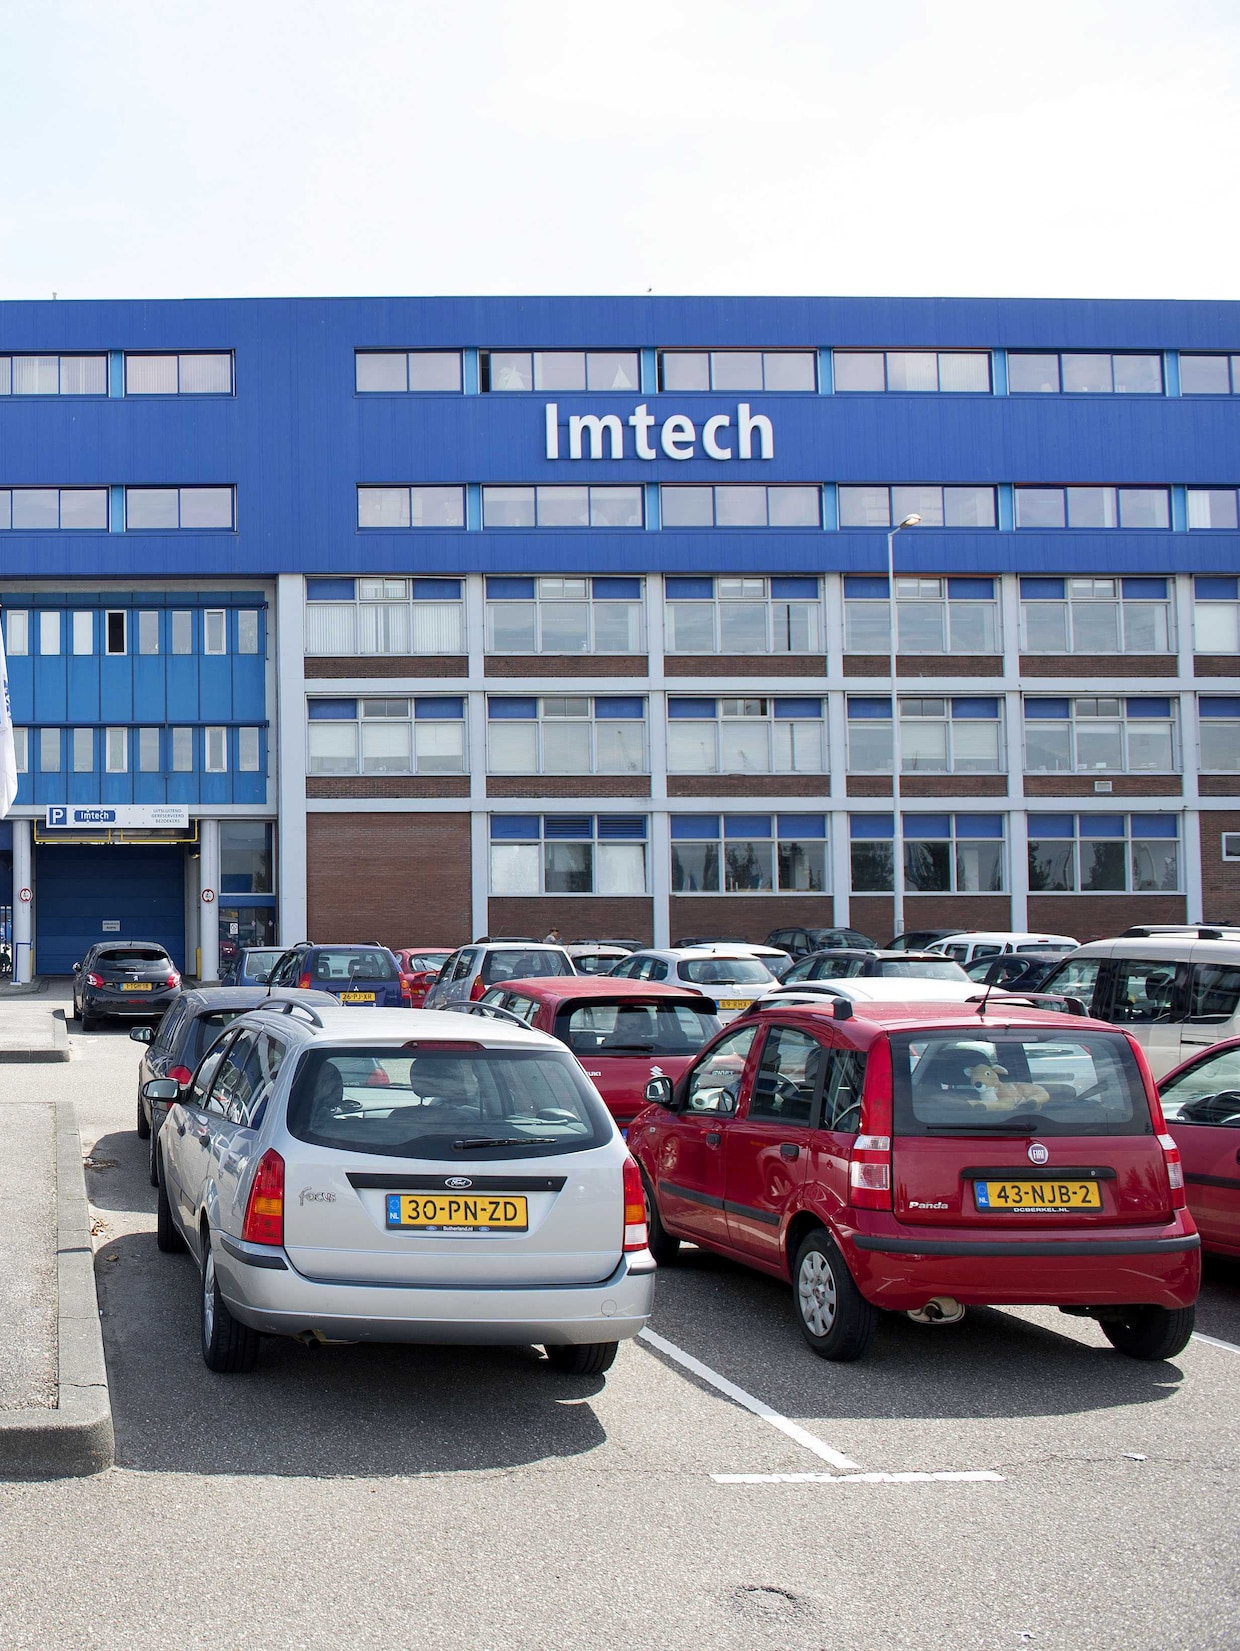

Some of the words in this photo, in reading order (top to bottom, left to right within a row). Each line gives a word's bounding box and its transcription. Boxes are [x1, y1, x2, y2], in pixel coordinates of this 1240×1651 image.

[545, 403, 774, 461] Imtech
[52, 809, 64, 824] P
[80, 811, 110, 820] Imtech
[978, 1196, 988, 1204] NL
[997, 1184, 1092, 1204] 43-NJB-2
[389, 1212, 400, 1220] NL
[407, 1199, 518, 1221] 30-PN-ZD
[909, 1201, 949, 1209] Panda
